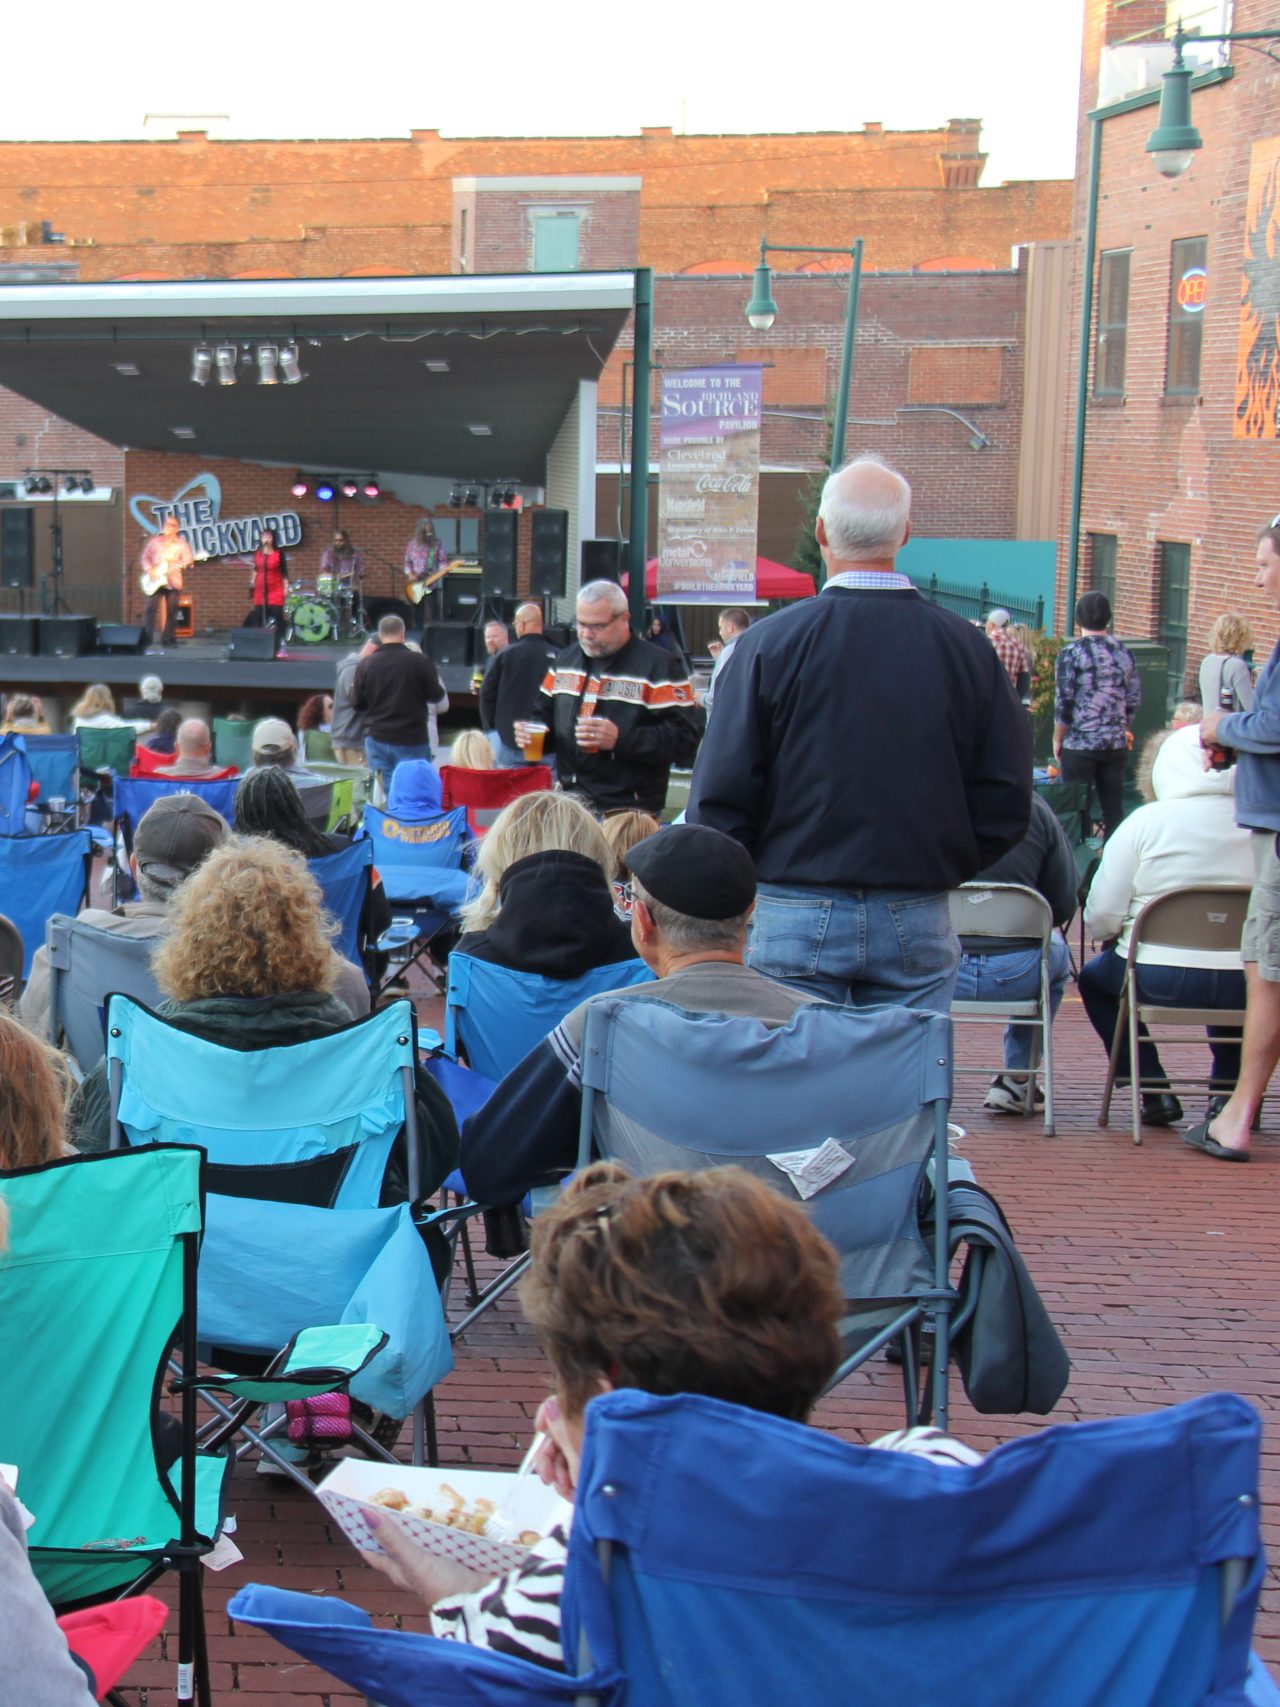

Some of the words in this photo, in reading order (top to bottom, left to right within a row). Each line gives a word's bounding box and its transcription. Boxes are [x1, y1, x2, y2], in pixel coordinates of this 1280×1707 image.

[1178, 280, 1206, 305] OPE
[663, 378, 707, 389] WELCOME
[710, 378, 722, 389] TO
[724, 377, 742, 388] THE
[663, 393, 759, 417] SOURCE
[719, 420, 758, 430] PAVILION
[667, 449, 727, 460] Cleveland
[151, 498, 214, 530] THE
[666, 498, 706, 513] Mansfield
[157, 512, 303, 558] RICKYARD
